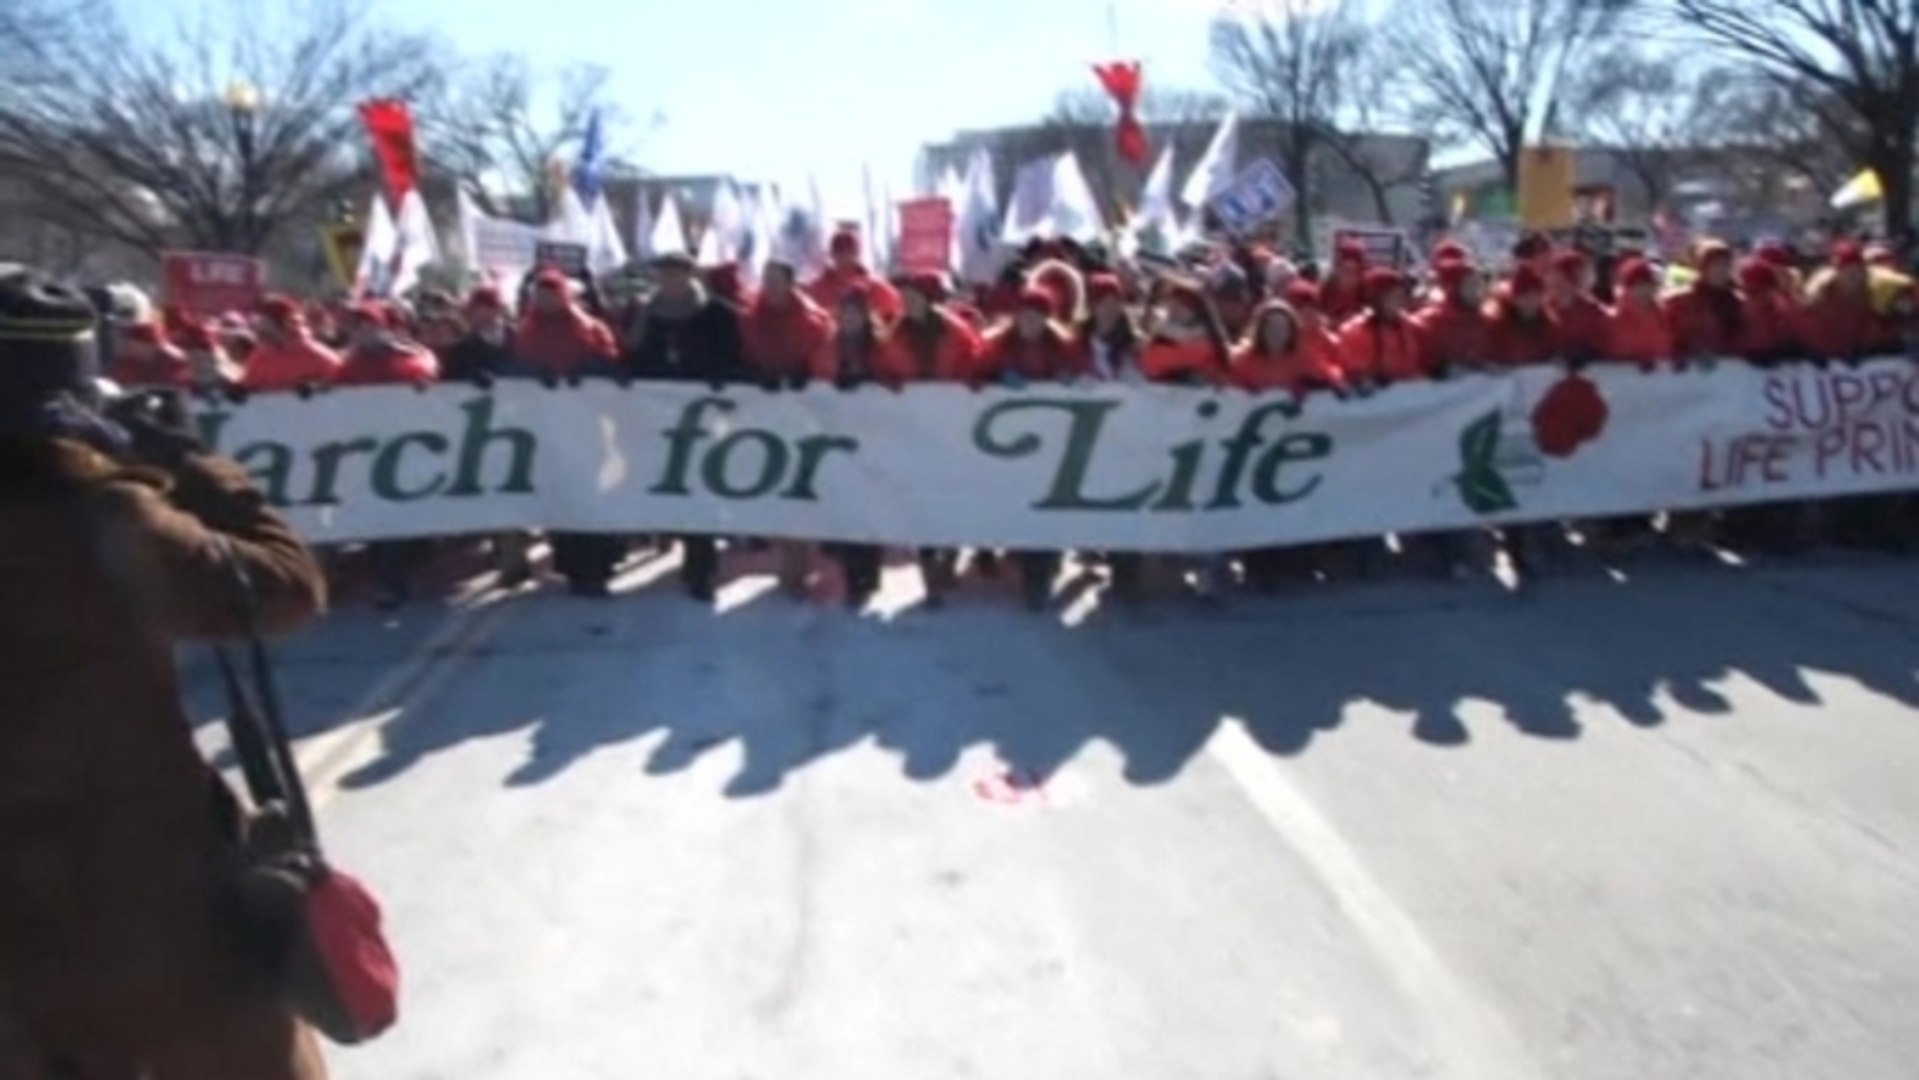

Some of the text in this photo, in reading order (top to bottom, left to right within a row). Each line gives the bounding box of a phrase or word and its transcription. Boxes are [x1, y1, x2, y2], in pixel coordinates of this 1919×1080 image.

[197, 396, 1334, 511] arch for Life
[1700, 434, 1798, 490] LIFE
